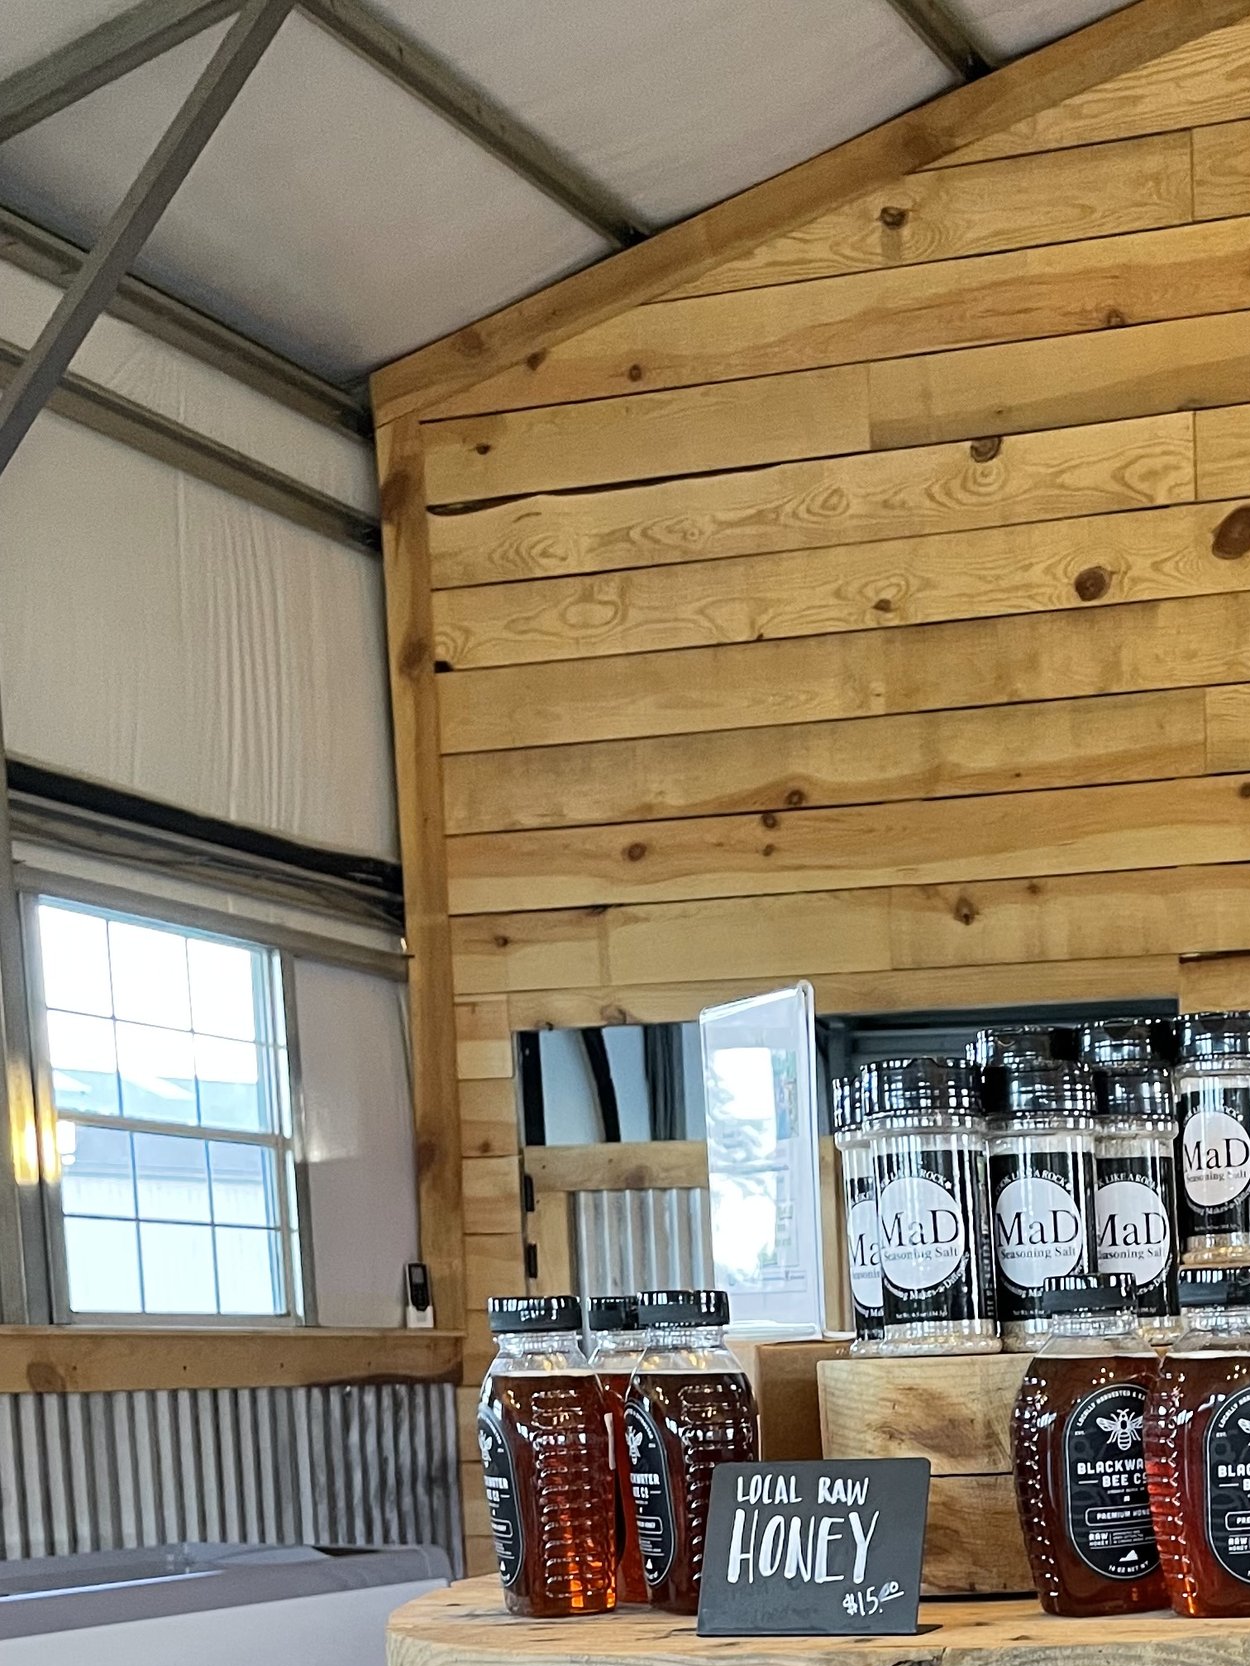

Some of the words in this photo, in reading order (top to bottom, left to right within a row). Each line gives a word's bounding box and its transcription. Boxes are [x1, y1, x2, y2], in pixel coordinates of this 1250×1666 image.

[1184, 1138, 1250, 1173] MaD
[881, 1209, 959, 1249] MaD
[996, 1209, 1079, 1248] MaD
[850, 1233, 880, 1266] Ma
[935, 1246, 959, 1258] Salt
[1000, 1247, 1051, 1260] Seasoning
[1055, 1247, 1076, 1257] Salt
[737, 1474, 802, 1504] LOCAL
[818, 1476, 869, 1506] RAW
[1102, 1474, 1129, 1488] BEE
[1096, 1509, 1131, 1520] PREMIUM
[727, 1508, 880, 1584] HONEY
[1088, 1532, 1109, 1541] RAW
[1228, 1537, 1248, 1546] RAW
